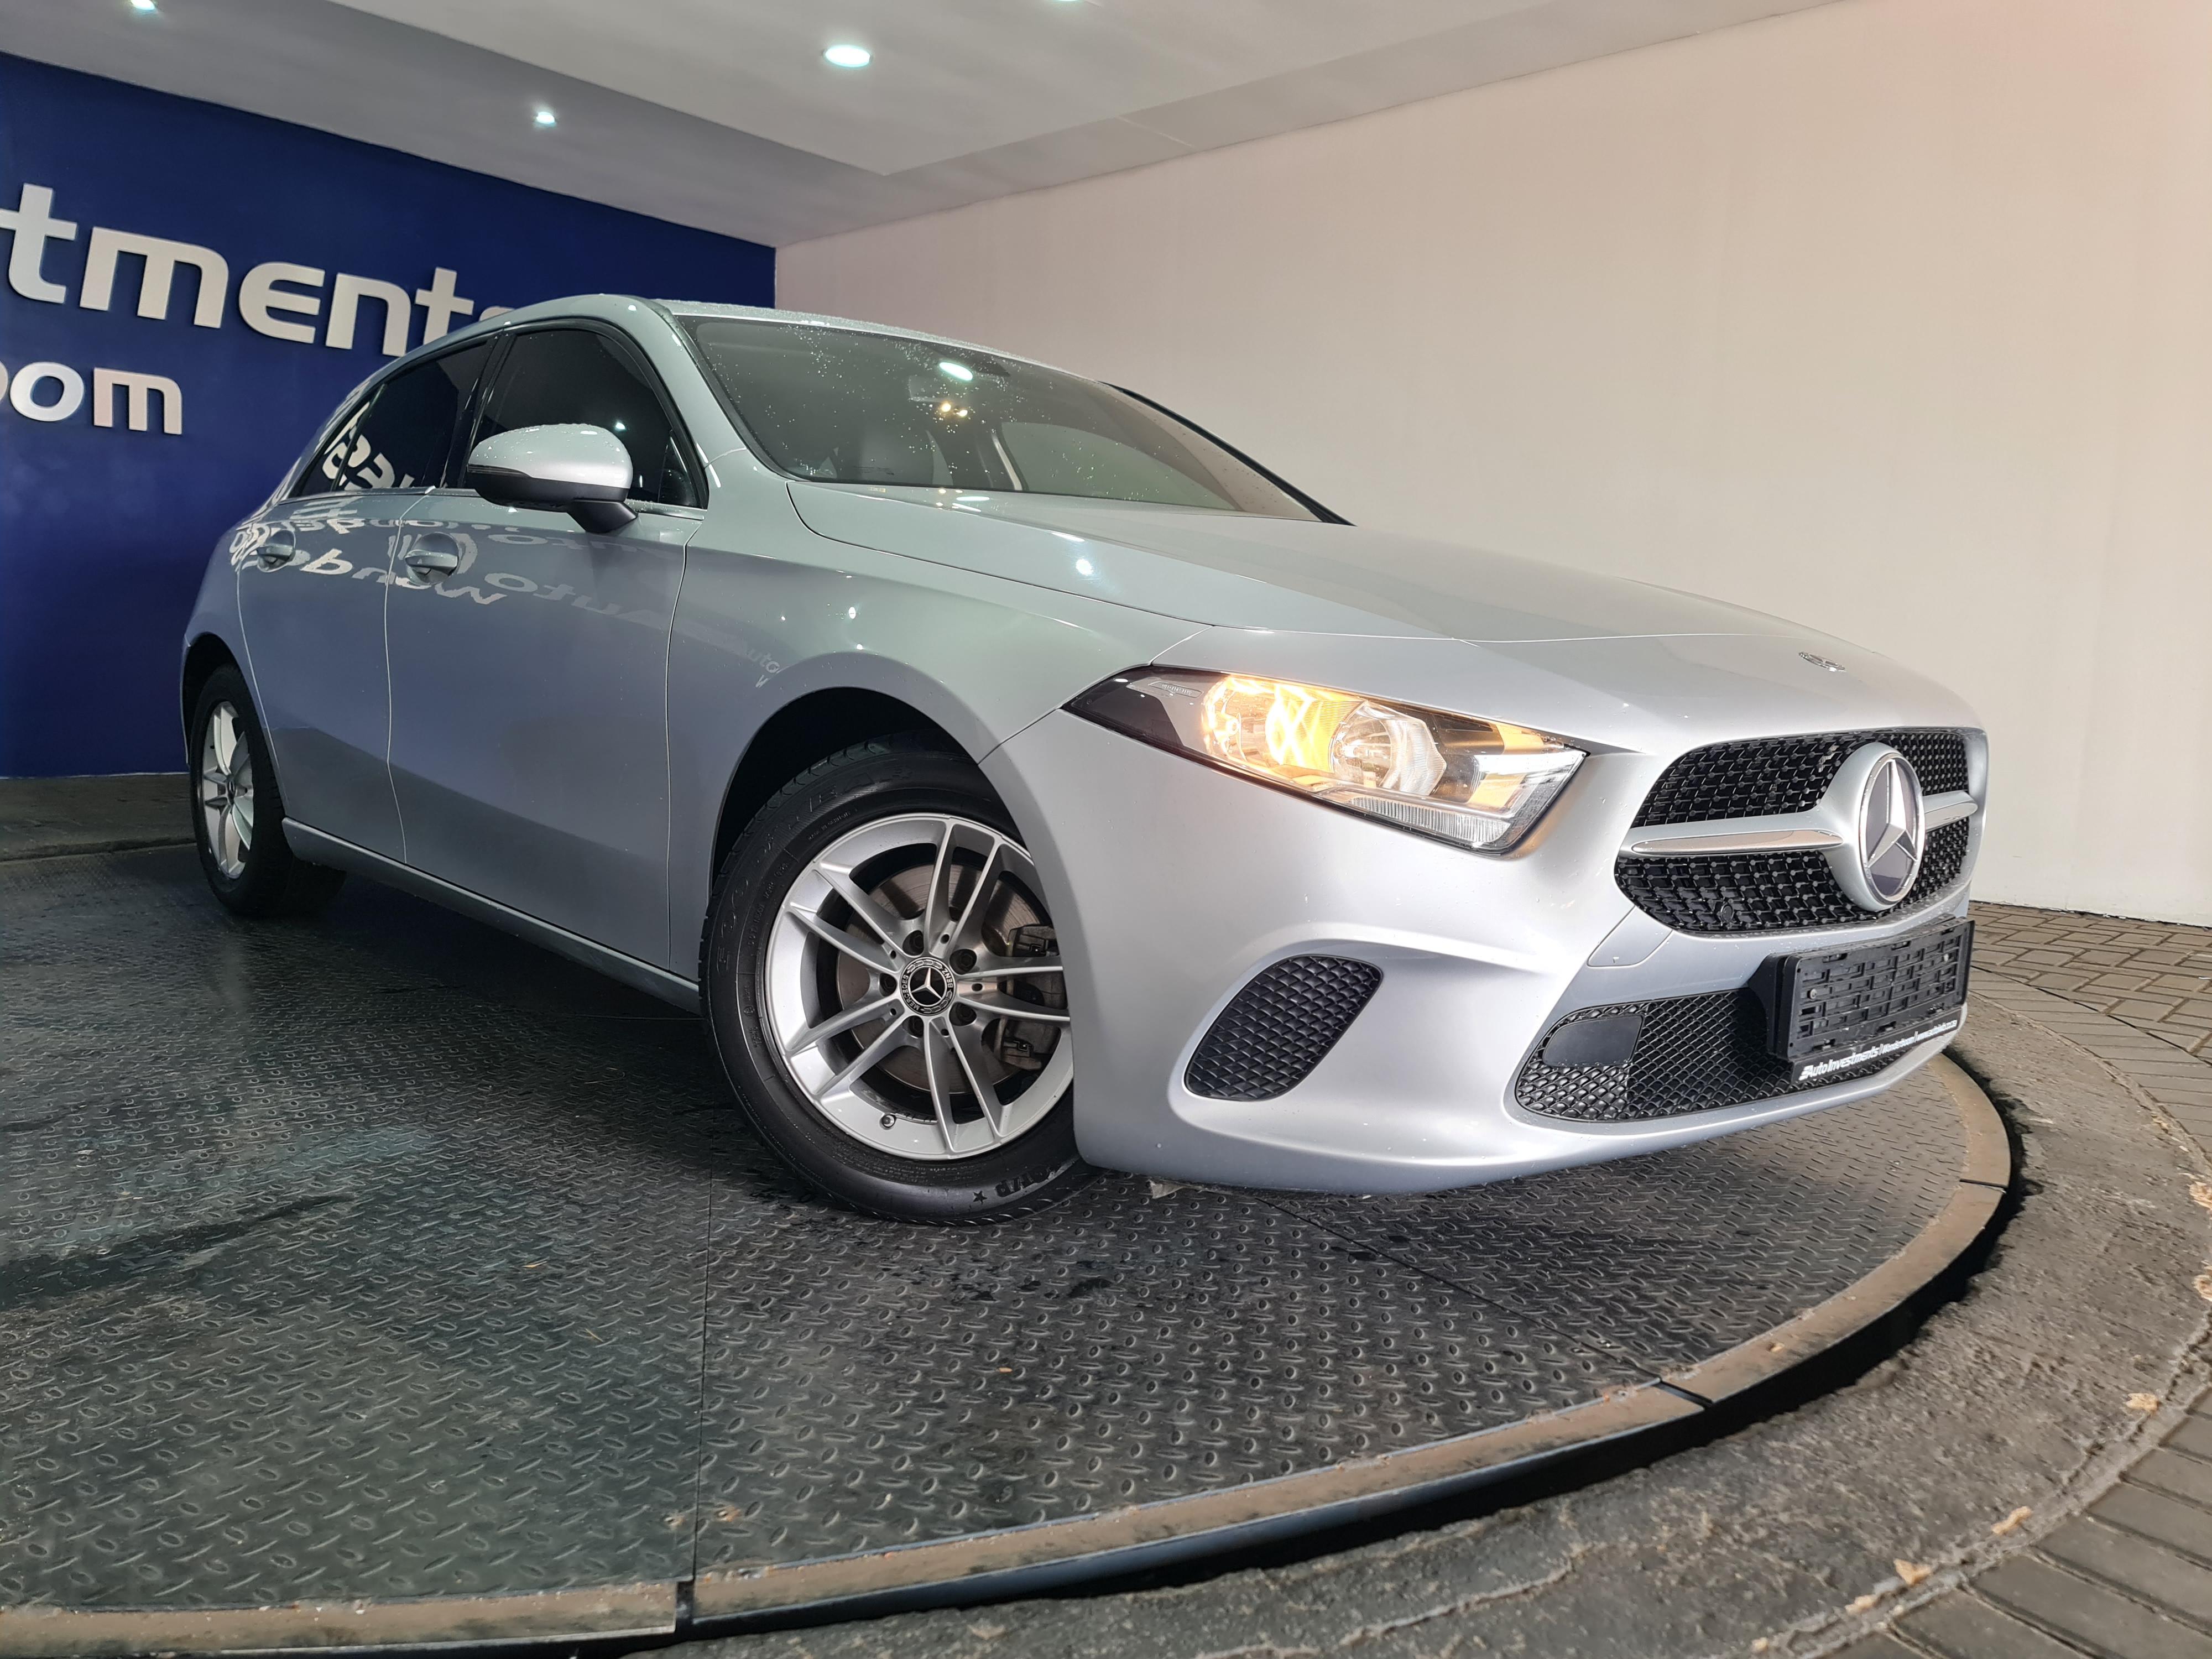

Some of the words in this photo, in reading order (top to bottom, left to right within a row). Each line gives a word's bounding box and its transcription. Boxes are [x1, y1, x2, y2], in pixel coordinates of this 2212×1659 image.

[0, 183, 515, 357] tment
[0, 361, 182, 435] om
[902, 975, 920, 1010] MERCEDES
[942, 968, 953, 988] BENZ
